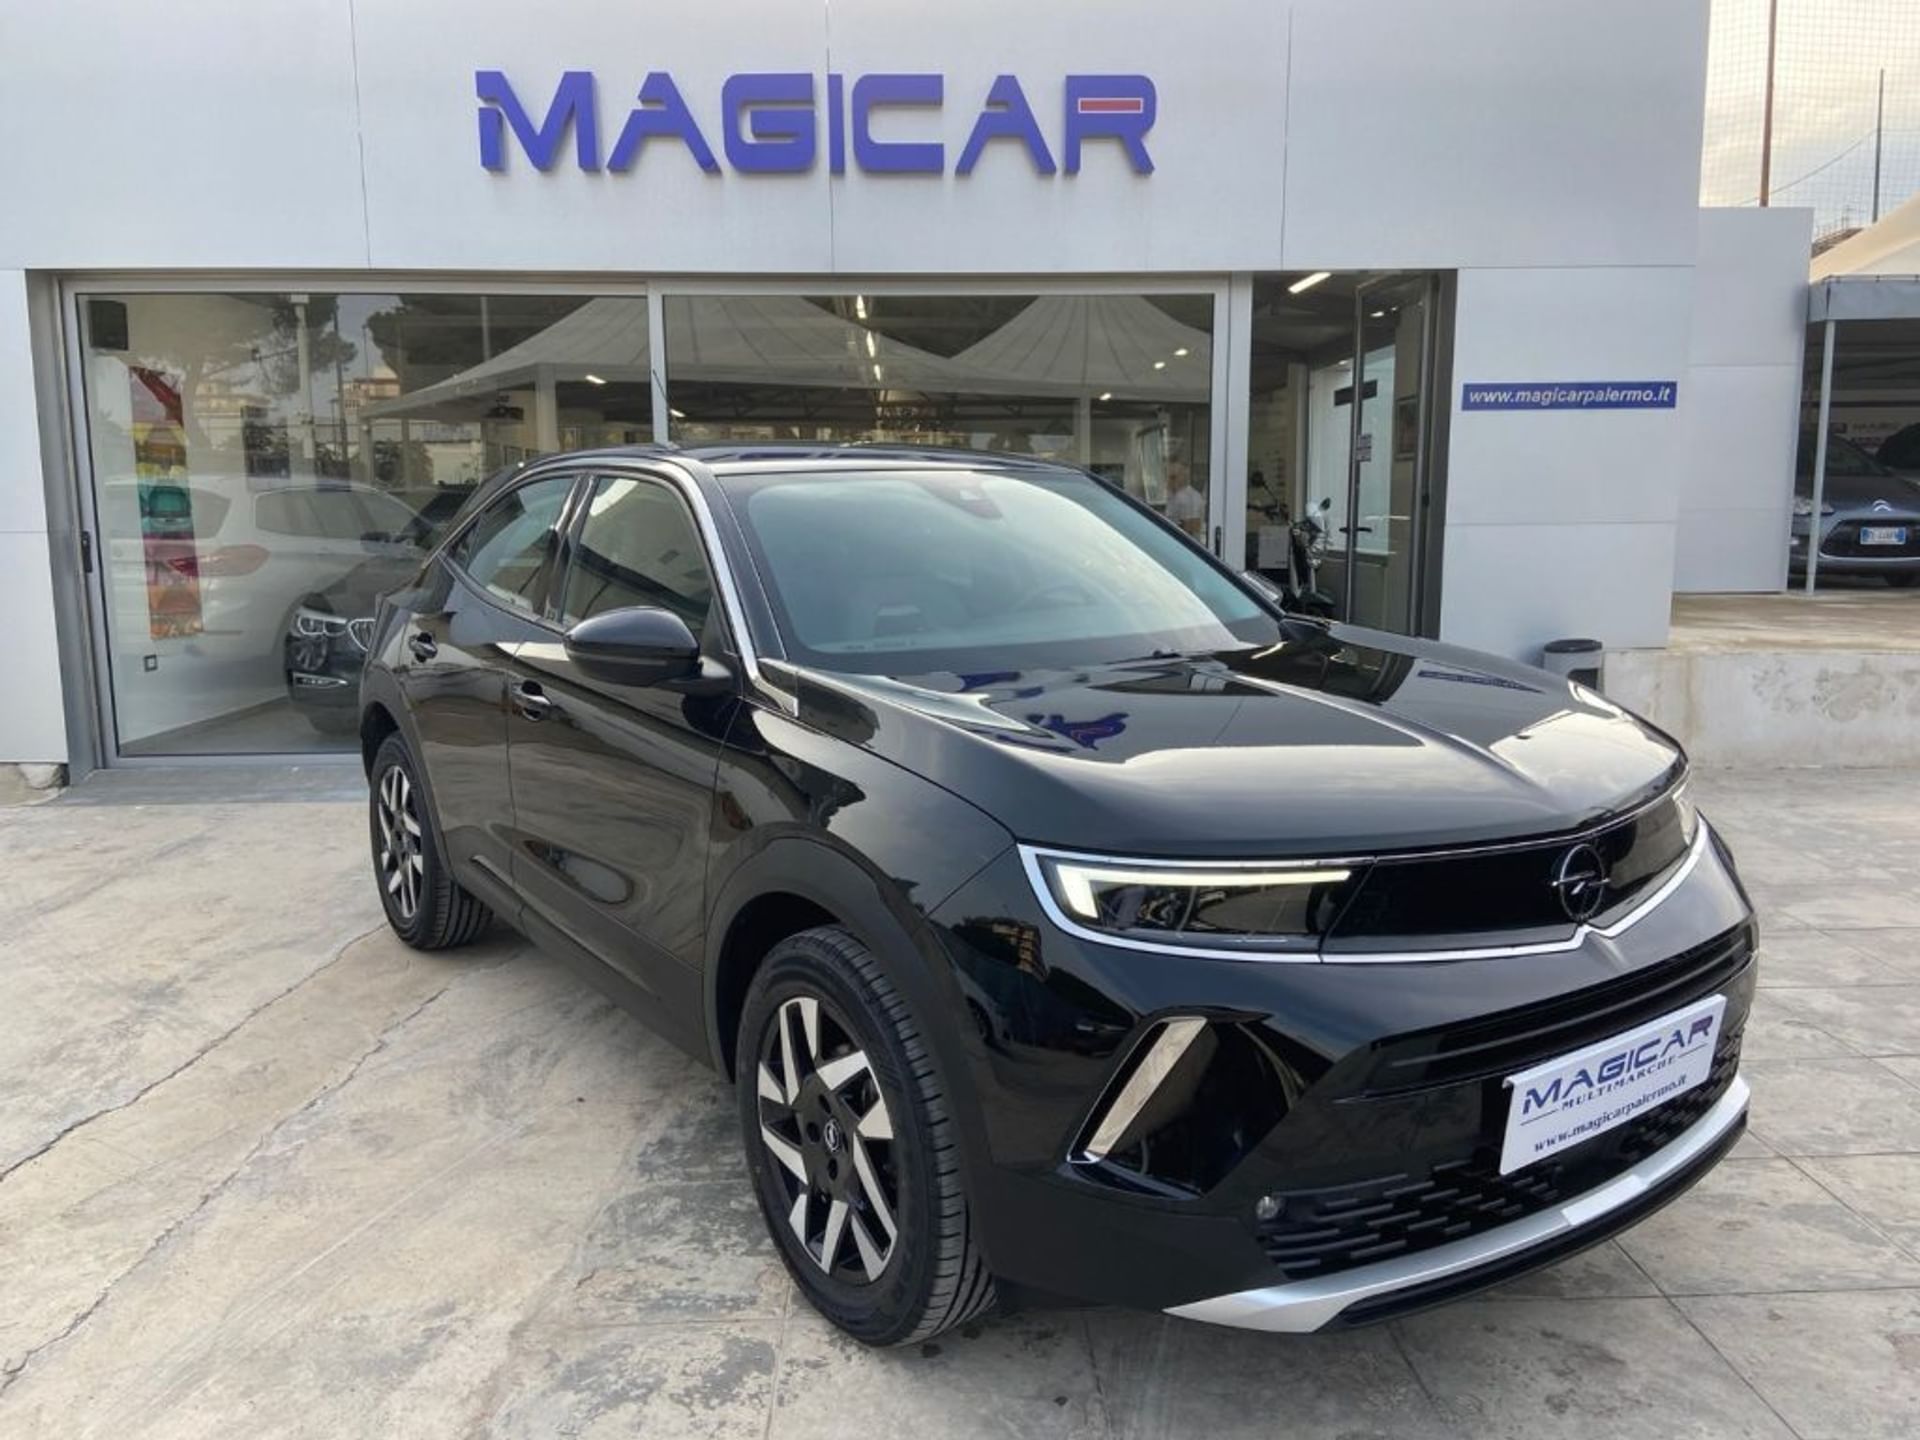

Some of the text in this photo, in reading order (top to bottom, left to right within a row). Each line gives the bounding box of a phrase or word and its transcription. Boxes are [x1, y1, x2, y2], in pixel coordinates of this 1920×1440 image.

[475, 71, 1156, 174] MAGICAR
[1468, 385, 1671, 406] www.magicarpalermo.it
[1522, 1015, 1713, 1114] MAGICAR
[1561, 1055, 1676, 1111] MULTIMARCHE
[1535, 1074, 1687, 1152] www.magicarpalermo.it
